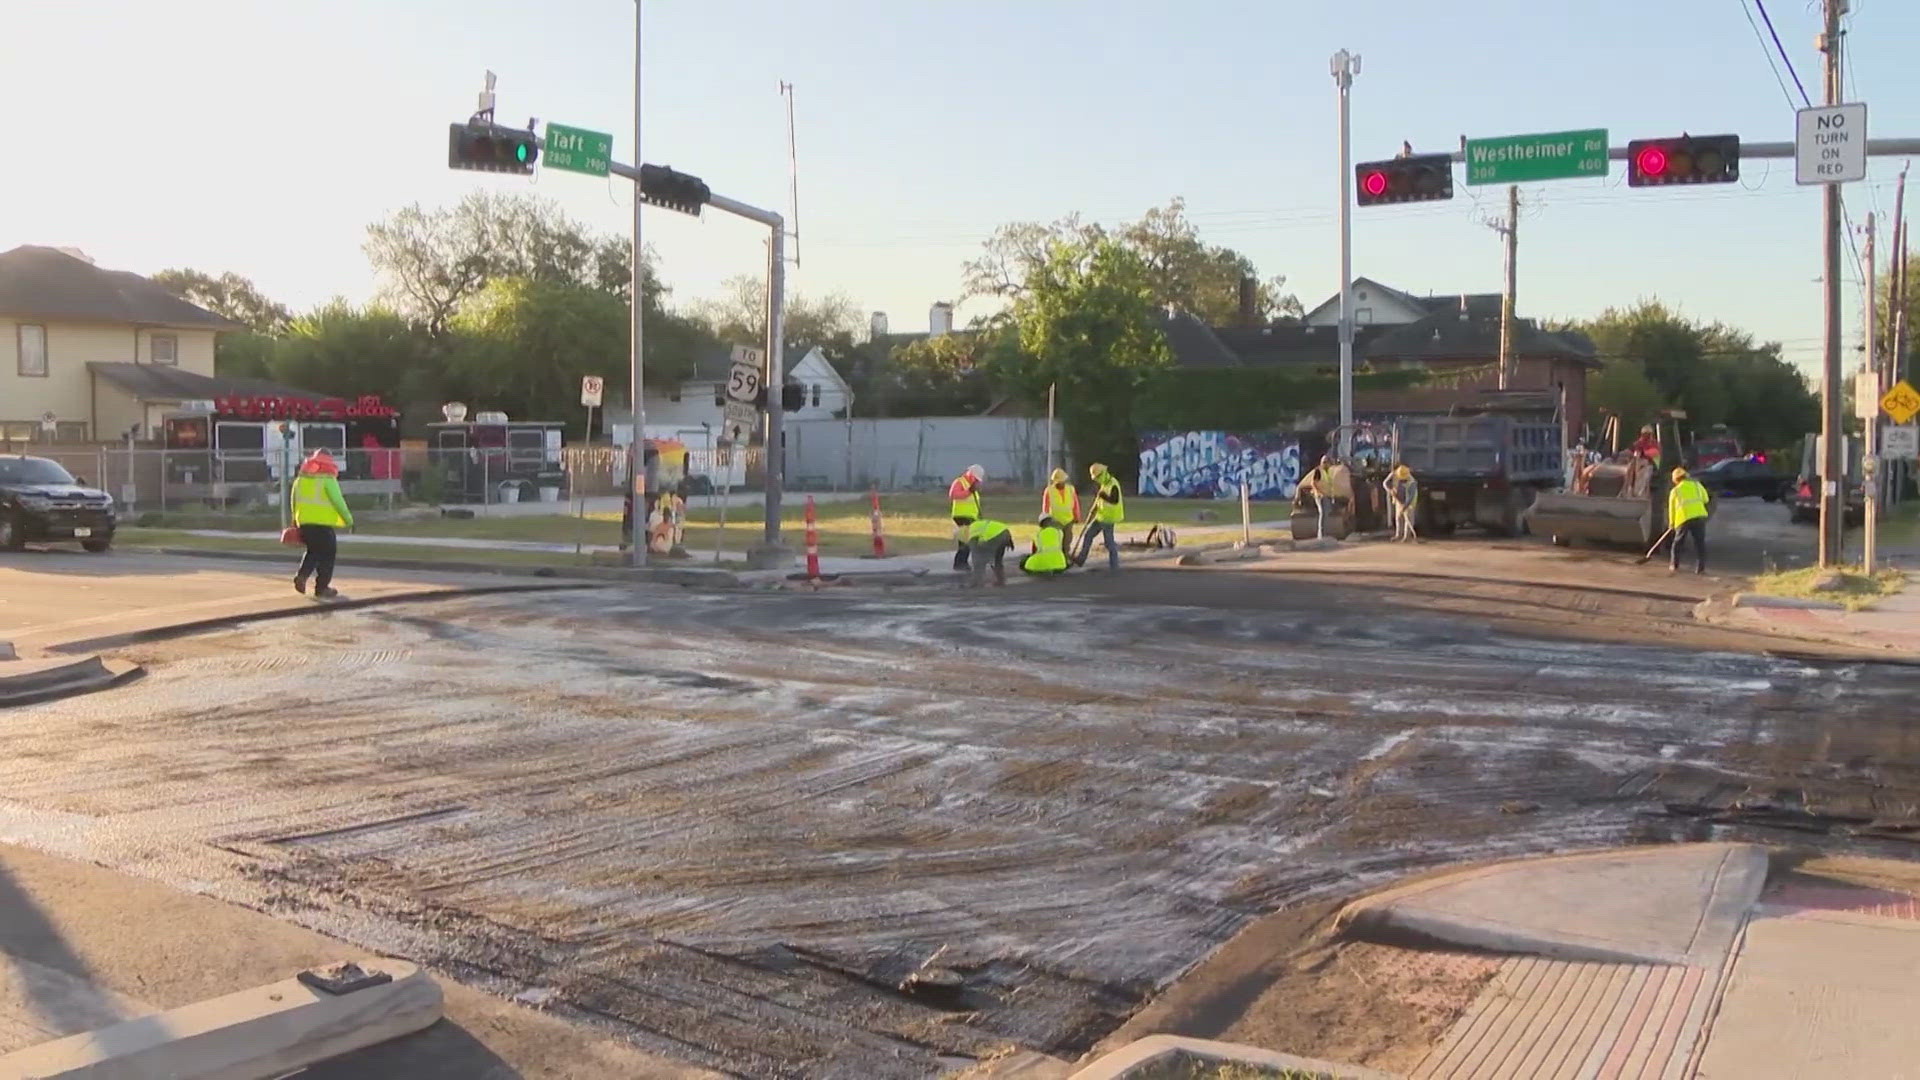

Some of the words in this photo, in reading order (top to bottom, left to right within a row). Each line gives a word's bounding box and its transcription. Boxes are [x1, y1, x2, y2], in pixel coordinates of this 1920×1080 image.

[1817, 113, 1845, 130] NO
[553, 130, 584, 152] Taft
[1814, 131, 1849, 145] TURN
[1472, 141, 1574, 163] Westheimer
[1584, 139, 1601, 151] Rd
[1821, 148, 1840, 160] ON
[1473, 166, 1496, 180] 300
[1577, 159, 1602, 171] 400
[1816, 163, 1844, 175] RED
[742, 349, 757, 361] TO
[730, 371, 758, 394] 59
[1138, 431, 1218, 497] REACH
